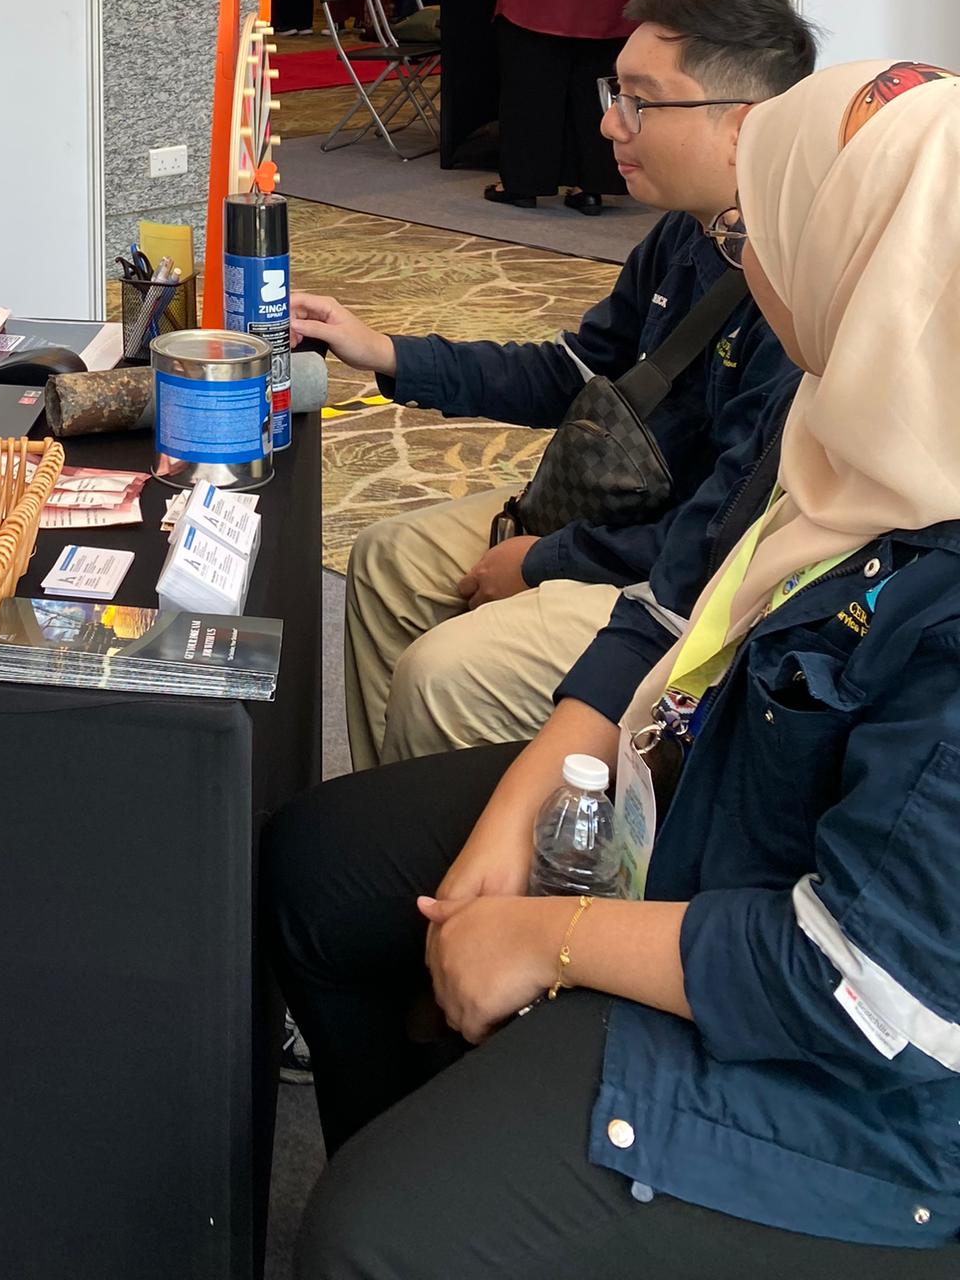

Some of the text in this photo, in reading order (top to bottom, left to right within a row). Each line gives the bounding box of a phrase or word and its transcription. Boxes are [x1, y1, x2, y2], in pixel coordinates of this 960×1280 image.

[258, 302, 287, 314] ZINGA
[266, 311, 284, 319] SPRAY
[836, 611, 860, 633] ervice
